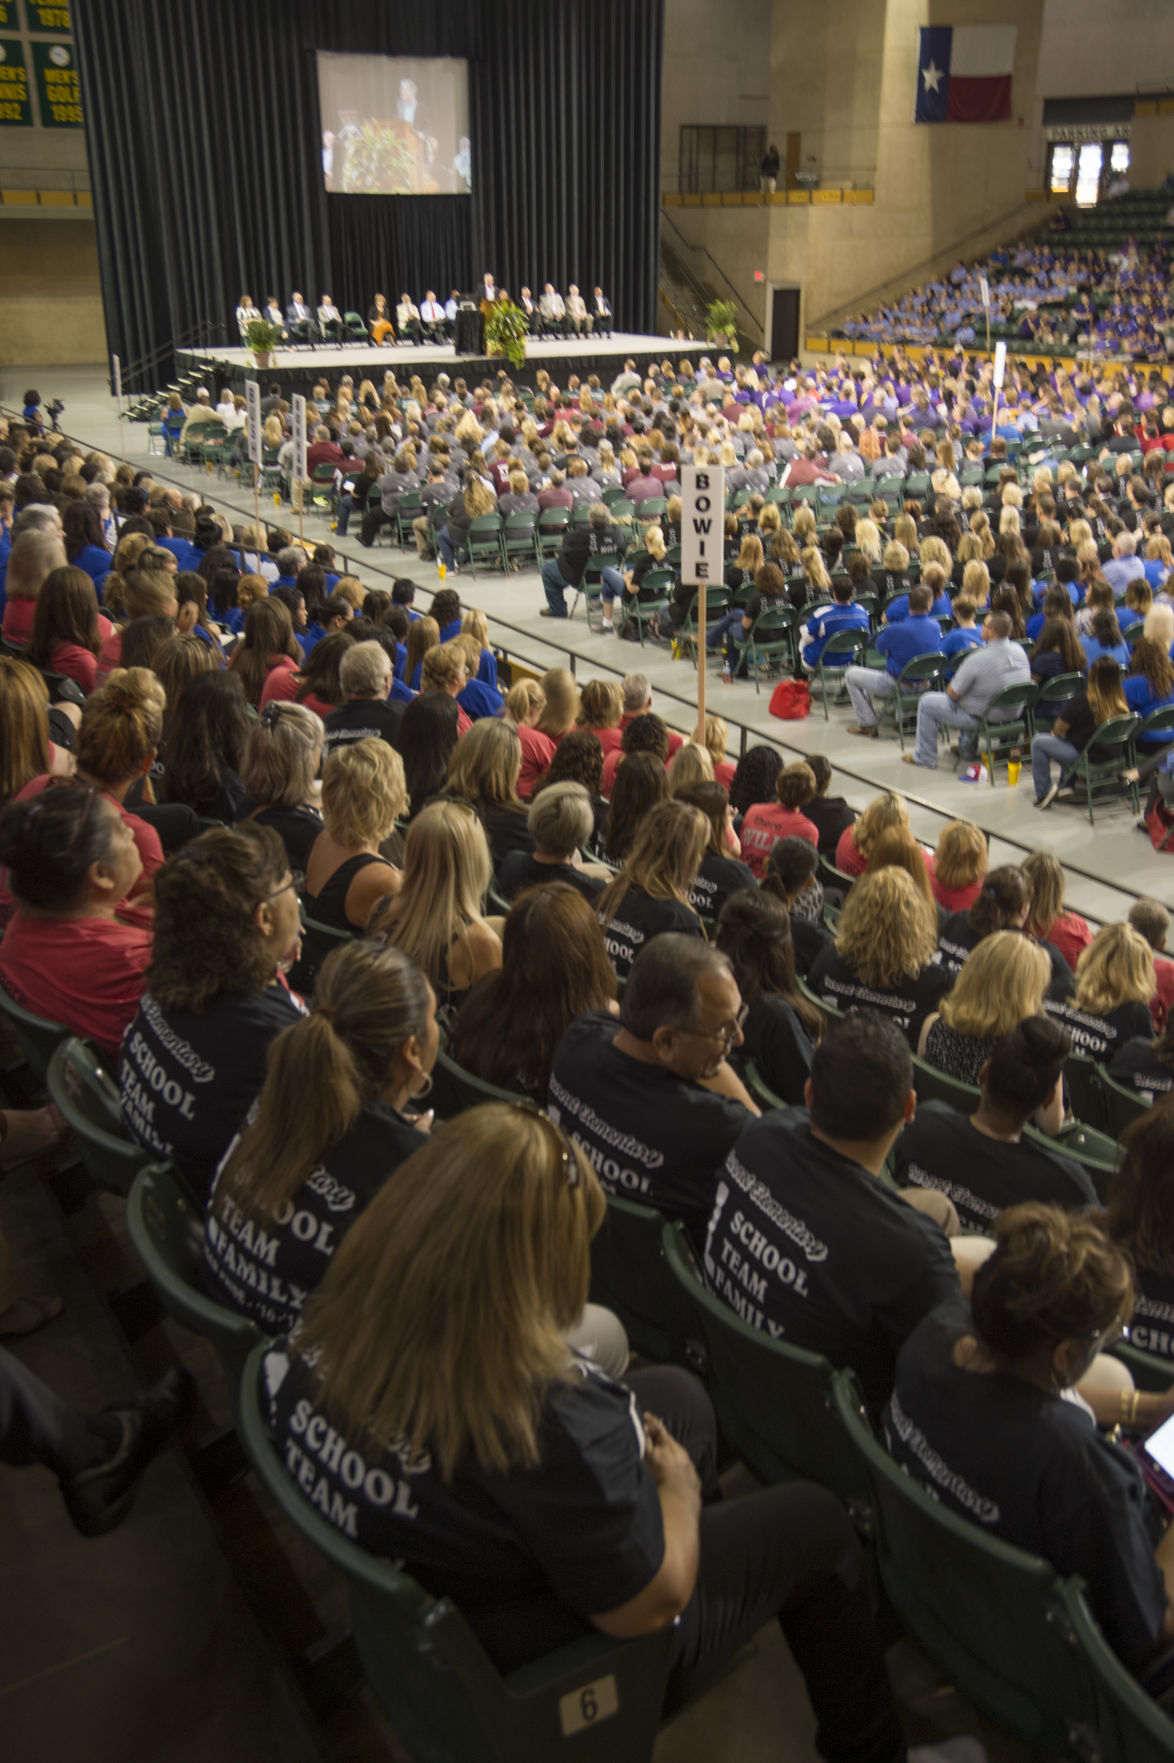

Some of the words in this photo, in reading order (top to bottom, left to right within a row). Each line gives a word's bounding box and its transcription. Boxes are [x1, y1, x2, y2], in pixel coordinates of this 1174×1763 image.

[693, 472, 712, 578] BOWIE
[121, 1058, 156, 1122] TEAM
[129, 1031, 196, 1121] SCHOOL
[216, 1230, 307, 1309] FAMILY
[222, 1194, 281, 1267] TEAM
[721, 1237, 768, 1304] TEAM
[730, 1210, 809, 1298] SCHOOL
[285, 1437, 359, 1538] TEAM
[288, 1399, 420, 1520] SCHOOL
[581, 1688, 598, 1721] 6
